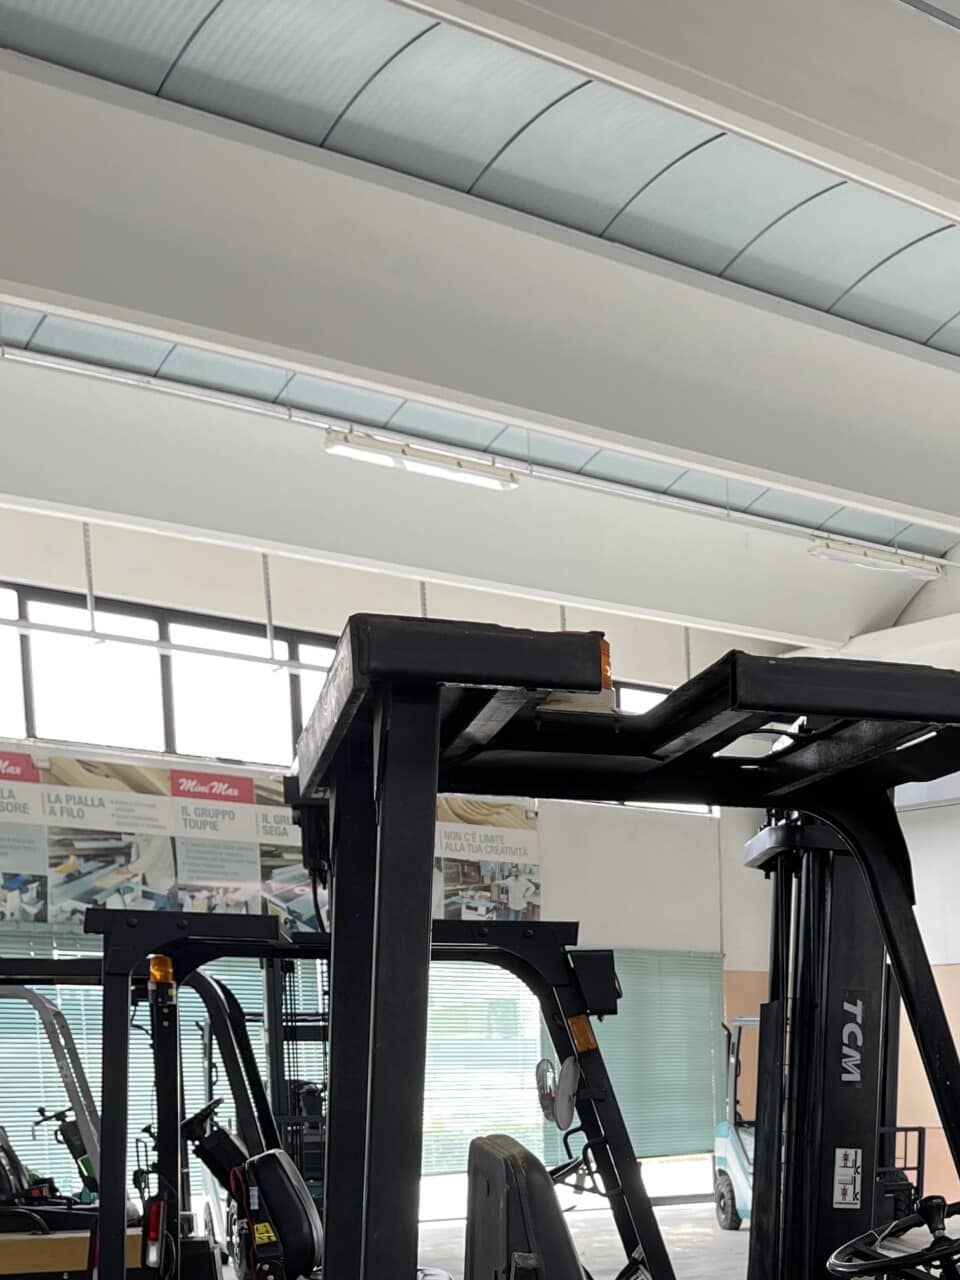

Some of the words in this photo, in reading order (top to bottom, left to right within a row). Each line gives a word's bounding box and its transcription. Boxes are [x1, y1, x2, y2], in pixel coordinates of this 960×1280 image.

[47, 792, 63, 804] LA
[65, 793, 106, 809] PIALLA
[48, 807, 58, 817] A
[60, 807, 85, 819] FILO
[181, 806, 191, 817] IL
[193, 807, 236, 820] GRUPPO
[261, 813, 271, 824] IL
[183, 818, 219, 831] TOUPIE
[262, 824, 289, 837] SEGA
[443, 830, 462, 841] NON
[444, 841, 466, 852] ALLA
[467, 843, 483, 854] TUA
[840, 999, 864, 1082] TCM
